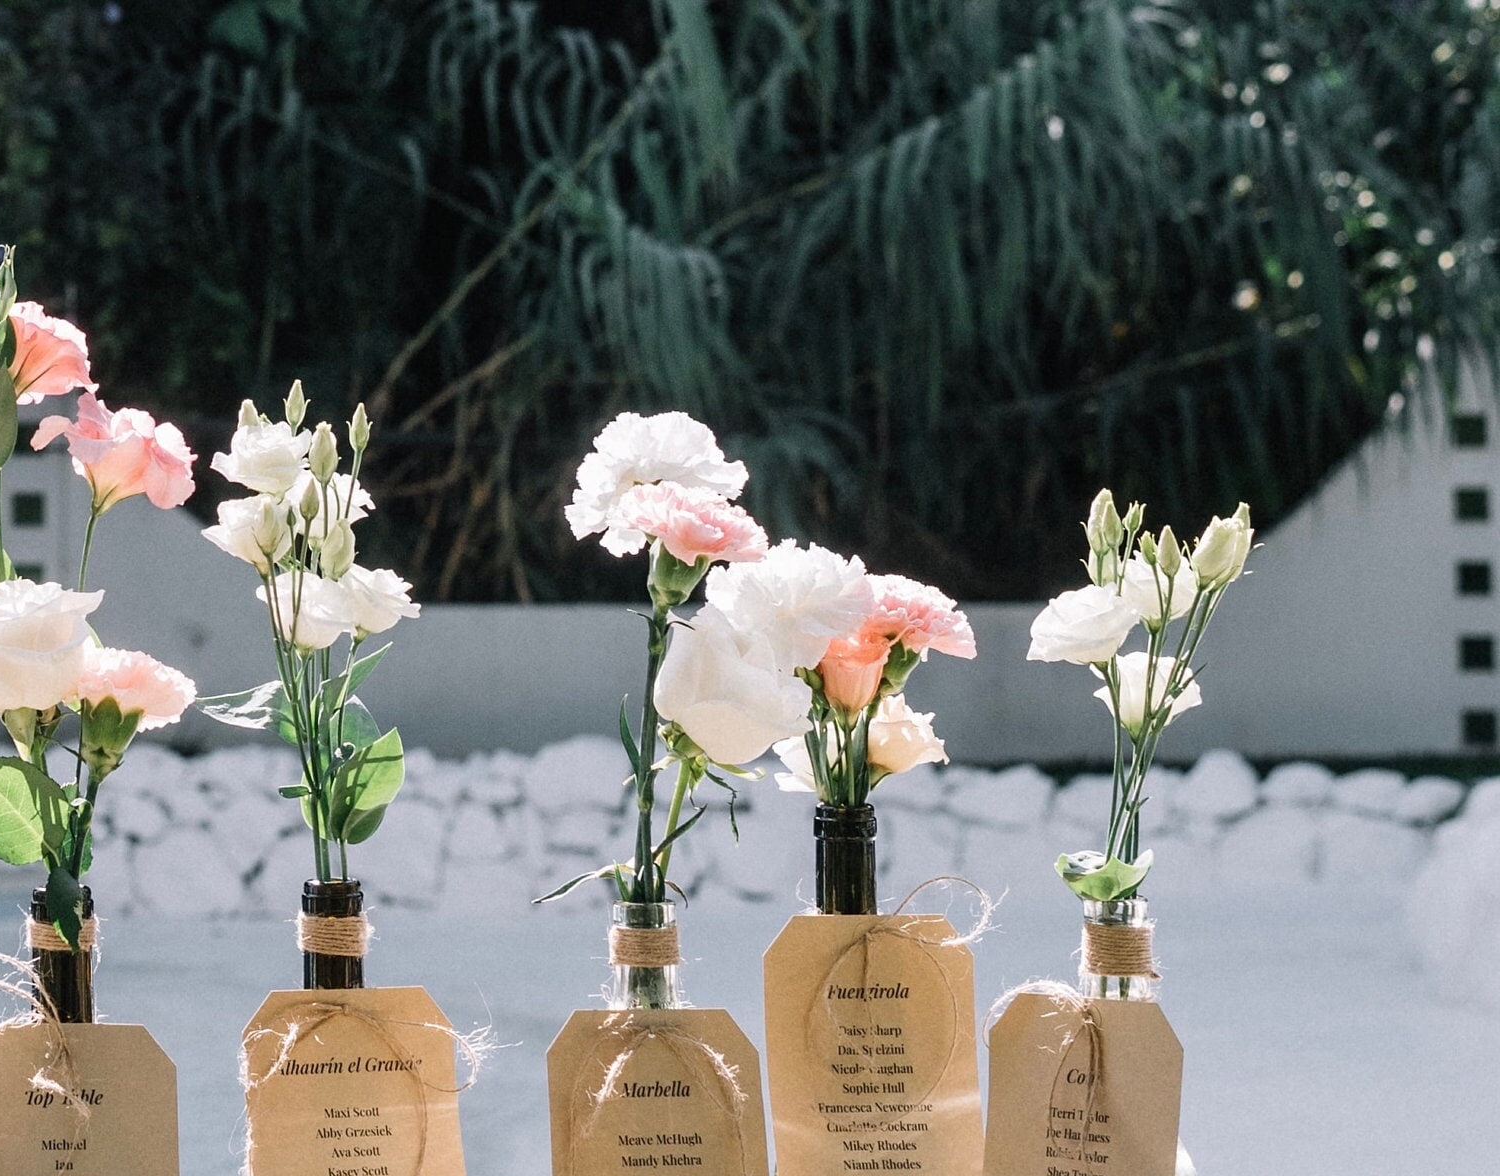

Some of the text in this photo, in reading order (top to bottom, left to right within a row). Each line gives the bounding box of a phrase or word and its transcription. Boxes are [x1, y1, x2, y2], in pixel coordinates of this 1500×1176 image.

[348, 1058, 361, 1073] el
[622, 1081, 690, 1098] Marbella
[843, 1082, 904, 1095] Sophie Hull
[24, 1089, 54, 1108] Top
[324, 1107, 379, 1118] Maxi Scott
[818, 1103, 872, 1113] Francesca
[1051, 1107, 1076, 1120] Terri
[316, 1128, 342, 1139] Abby
[619, 1133, 702, 1146] Meave McHugh
[332, 1147, 380, 1158] Ava Scott
[843, 1140, 917, 1153] Mikey Rhodes
[622, 1154, 702, 1168] Mandy Khehra
[844, 1159, 921, 1170] Niamh Rhodes
[362, 1166, 388, 1176] Scott
